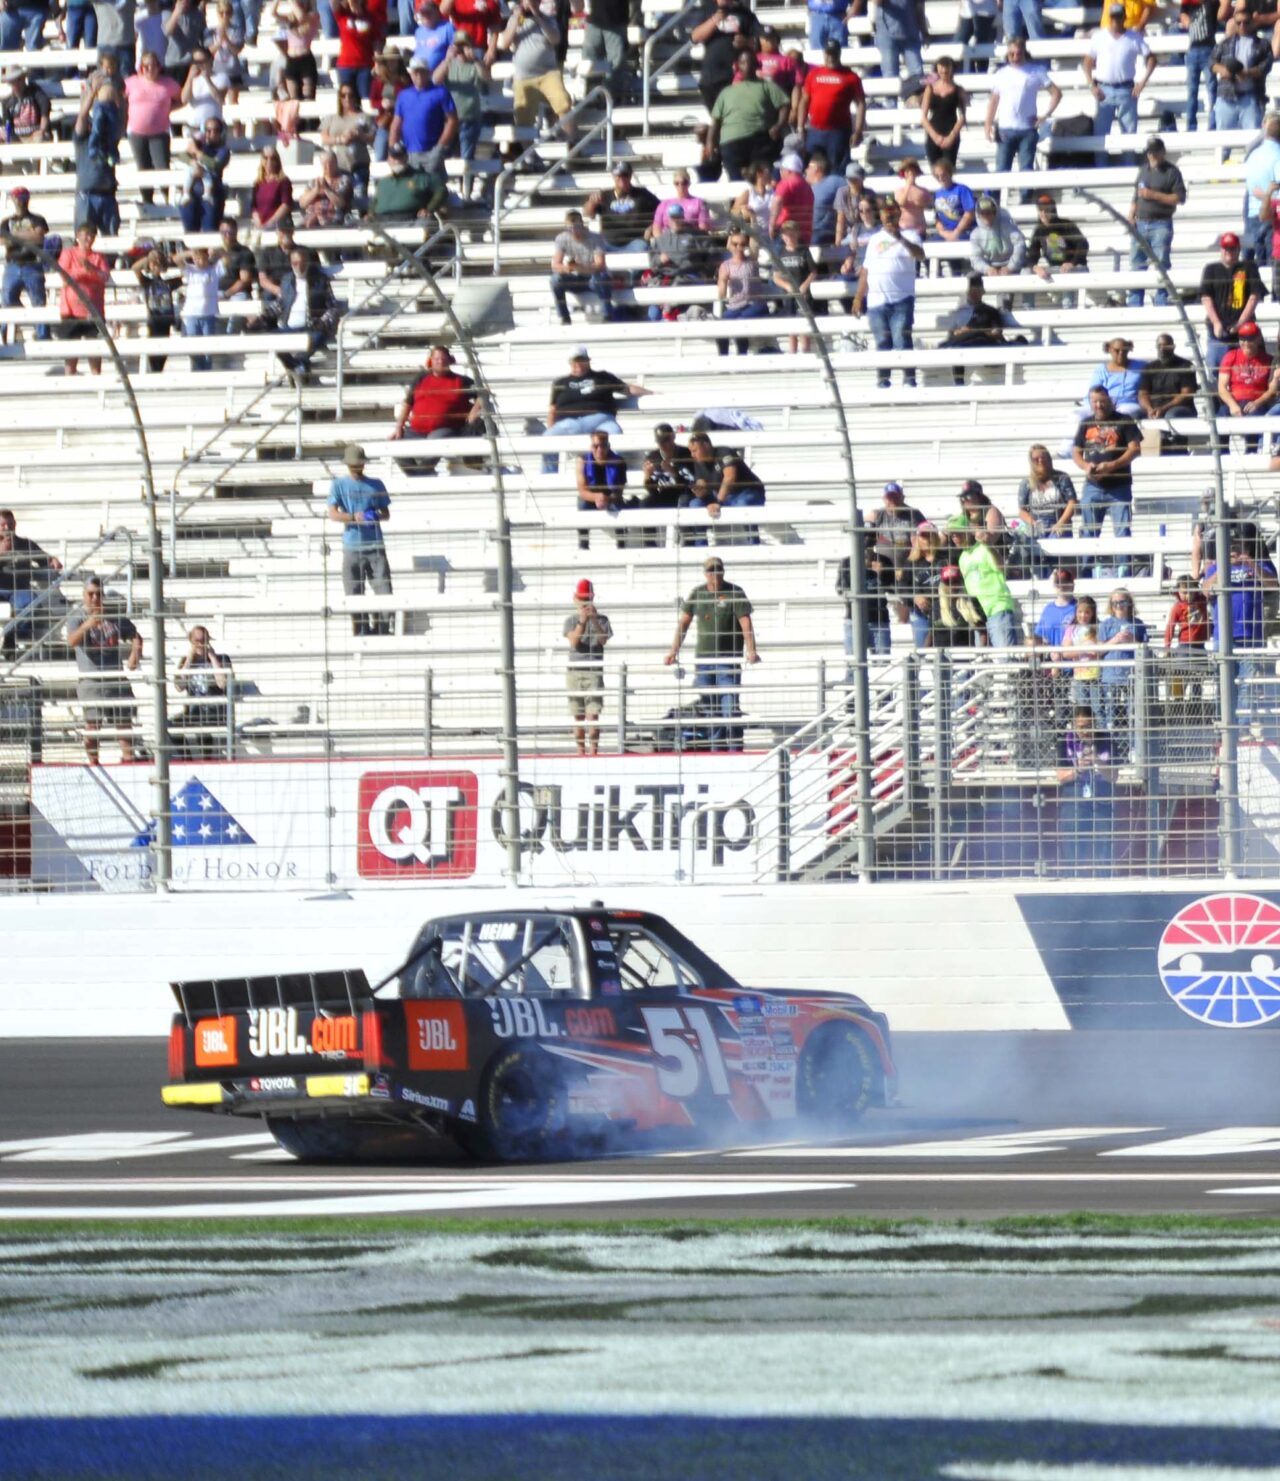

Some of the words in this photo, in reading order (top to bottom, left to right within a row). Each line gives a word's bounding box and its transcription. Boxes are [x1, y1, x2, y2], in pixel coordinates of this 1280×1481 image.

[368, 785, 464, 866] QT
[490, 781, 757, 866] QuikTrip
[89, 859, 154, 880] FOLD
[175, 857, 195, 883] of
[204, 858, 298, 879] HONOR
[478, 922, 518, 941] HEIM
[202, 1029, 228, 1053] JBL
[417, 1018, 457, 1050] JBL
[640, 1007, 731, 1098] 51
[258, 1075, 297, 1091] TOYOTA
